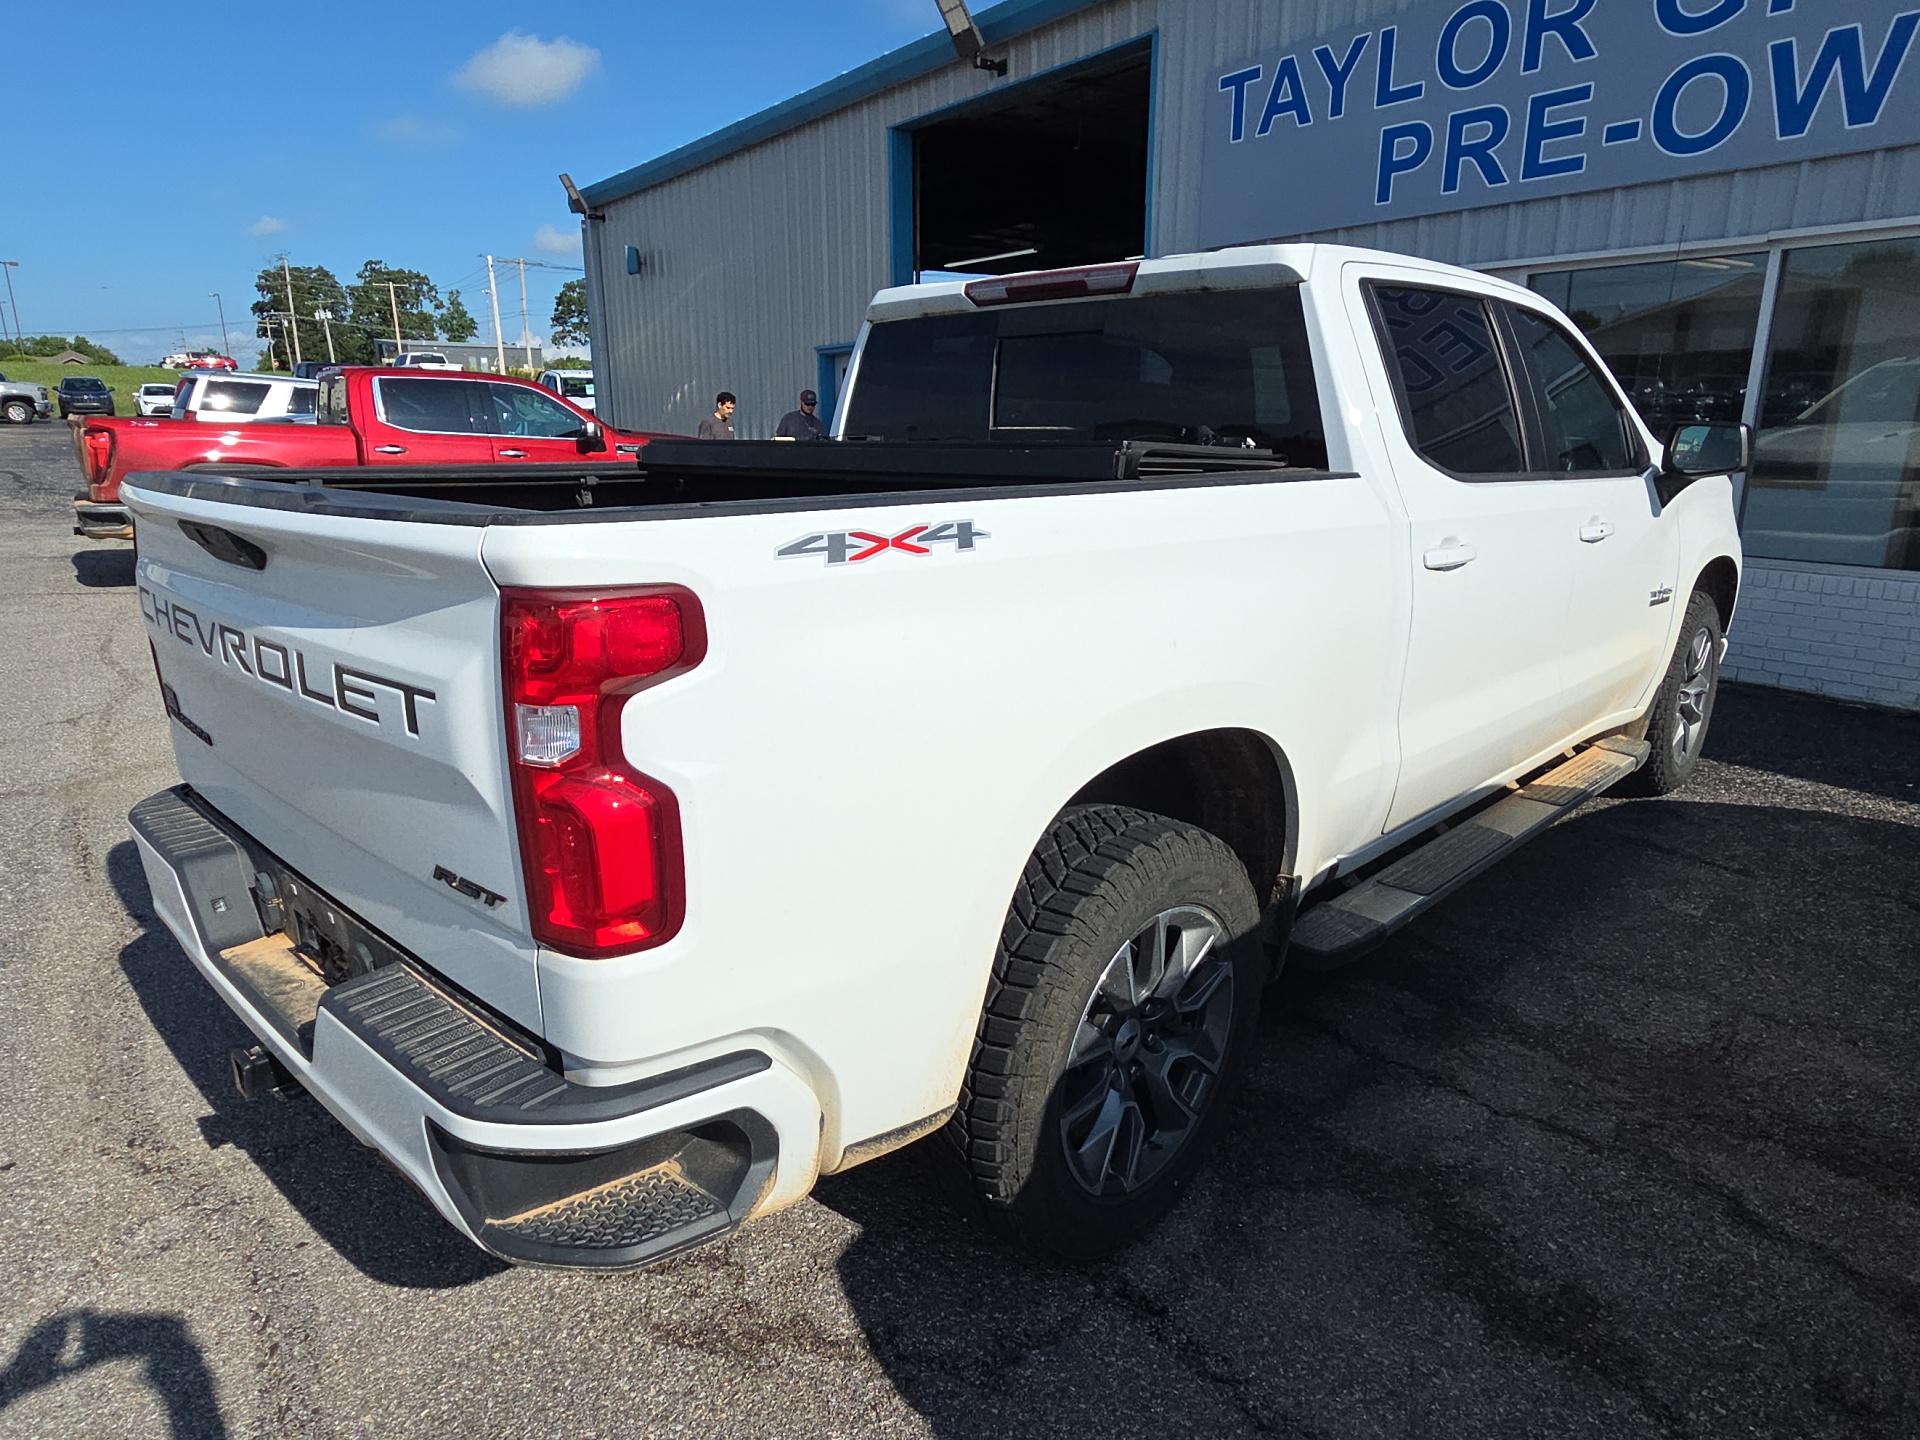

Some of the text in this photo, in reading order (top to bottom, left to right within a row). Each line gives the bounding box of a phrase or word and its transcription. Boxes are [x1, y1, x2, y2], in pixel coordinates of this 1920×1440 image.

[1219, 0, 1598, 143] TAYLOR
[775, 518, 991, 566] 4X4
[138, 585, 436, 739] CHEVROLET
[432, 863, 509, 908] RST
